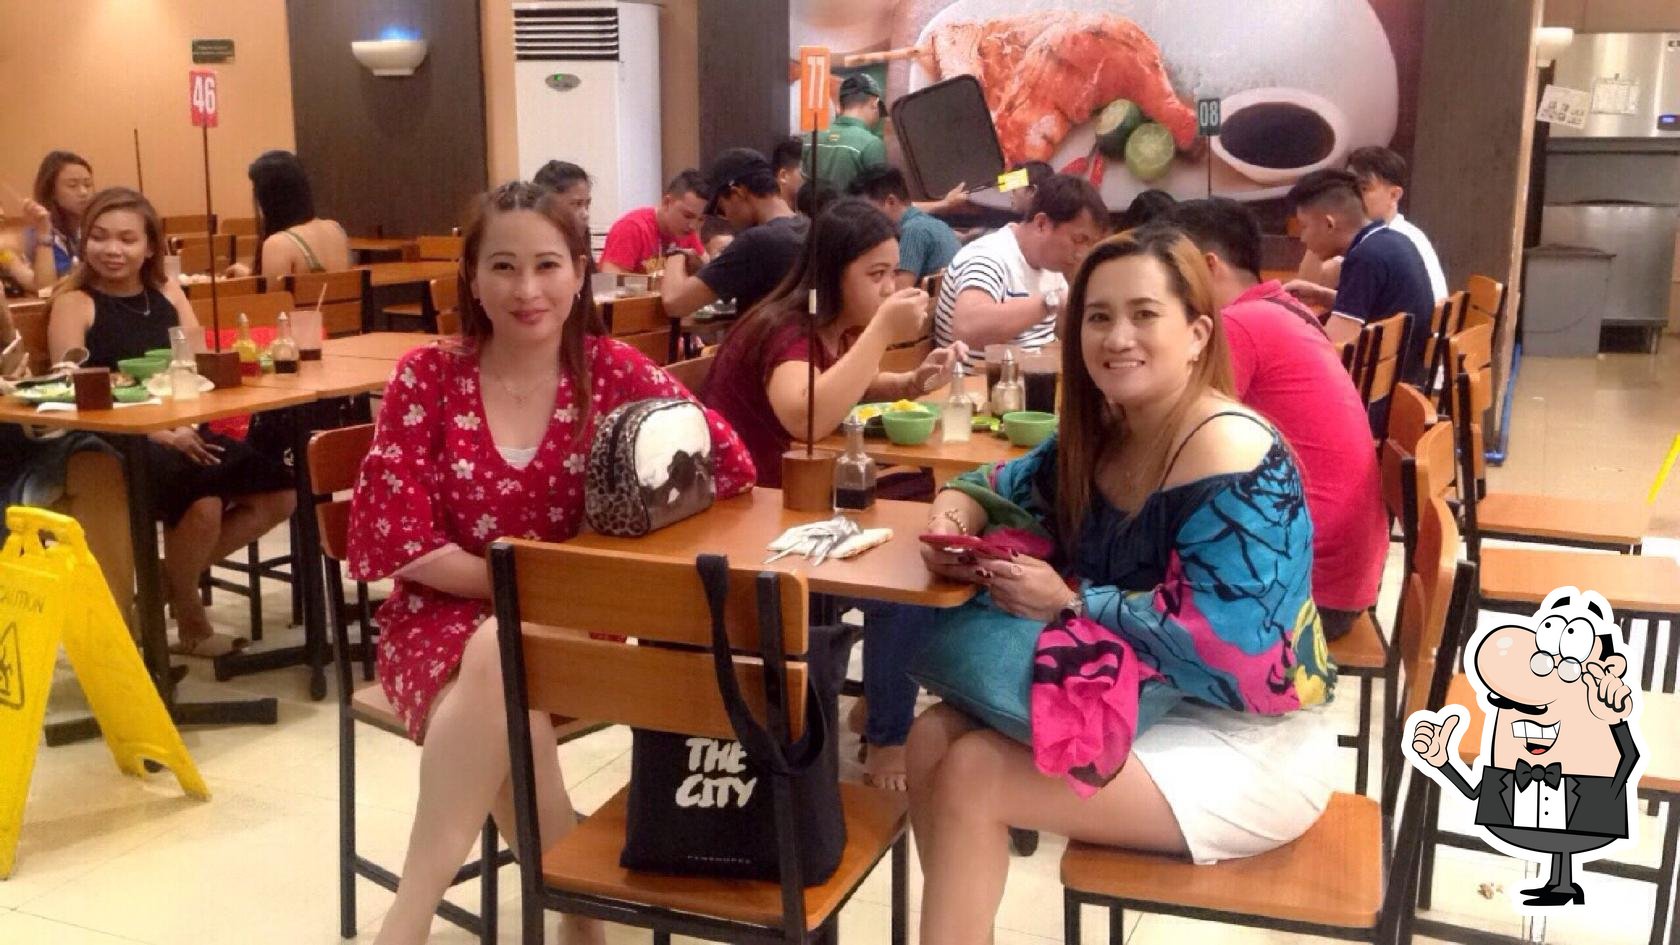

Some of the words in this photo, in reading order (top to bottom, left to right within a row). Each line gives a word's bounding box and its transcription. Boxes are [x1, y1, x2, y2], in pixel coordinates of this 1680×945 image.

[193, 75, 216, 115] 46
[1200, 101, 1219, 126] 08
[685, 737, 748, 773] THE
[675, 773, 758, 808] CITY
